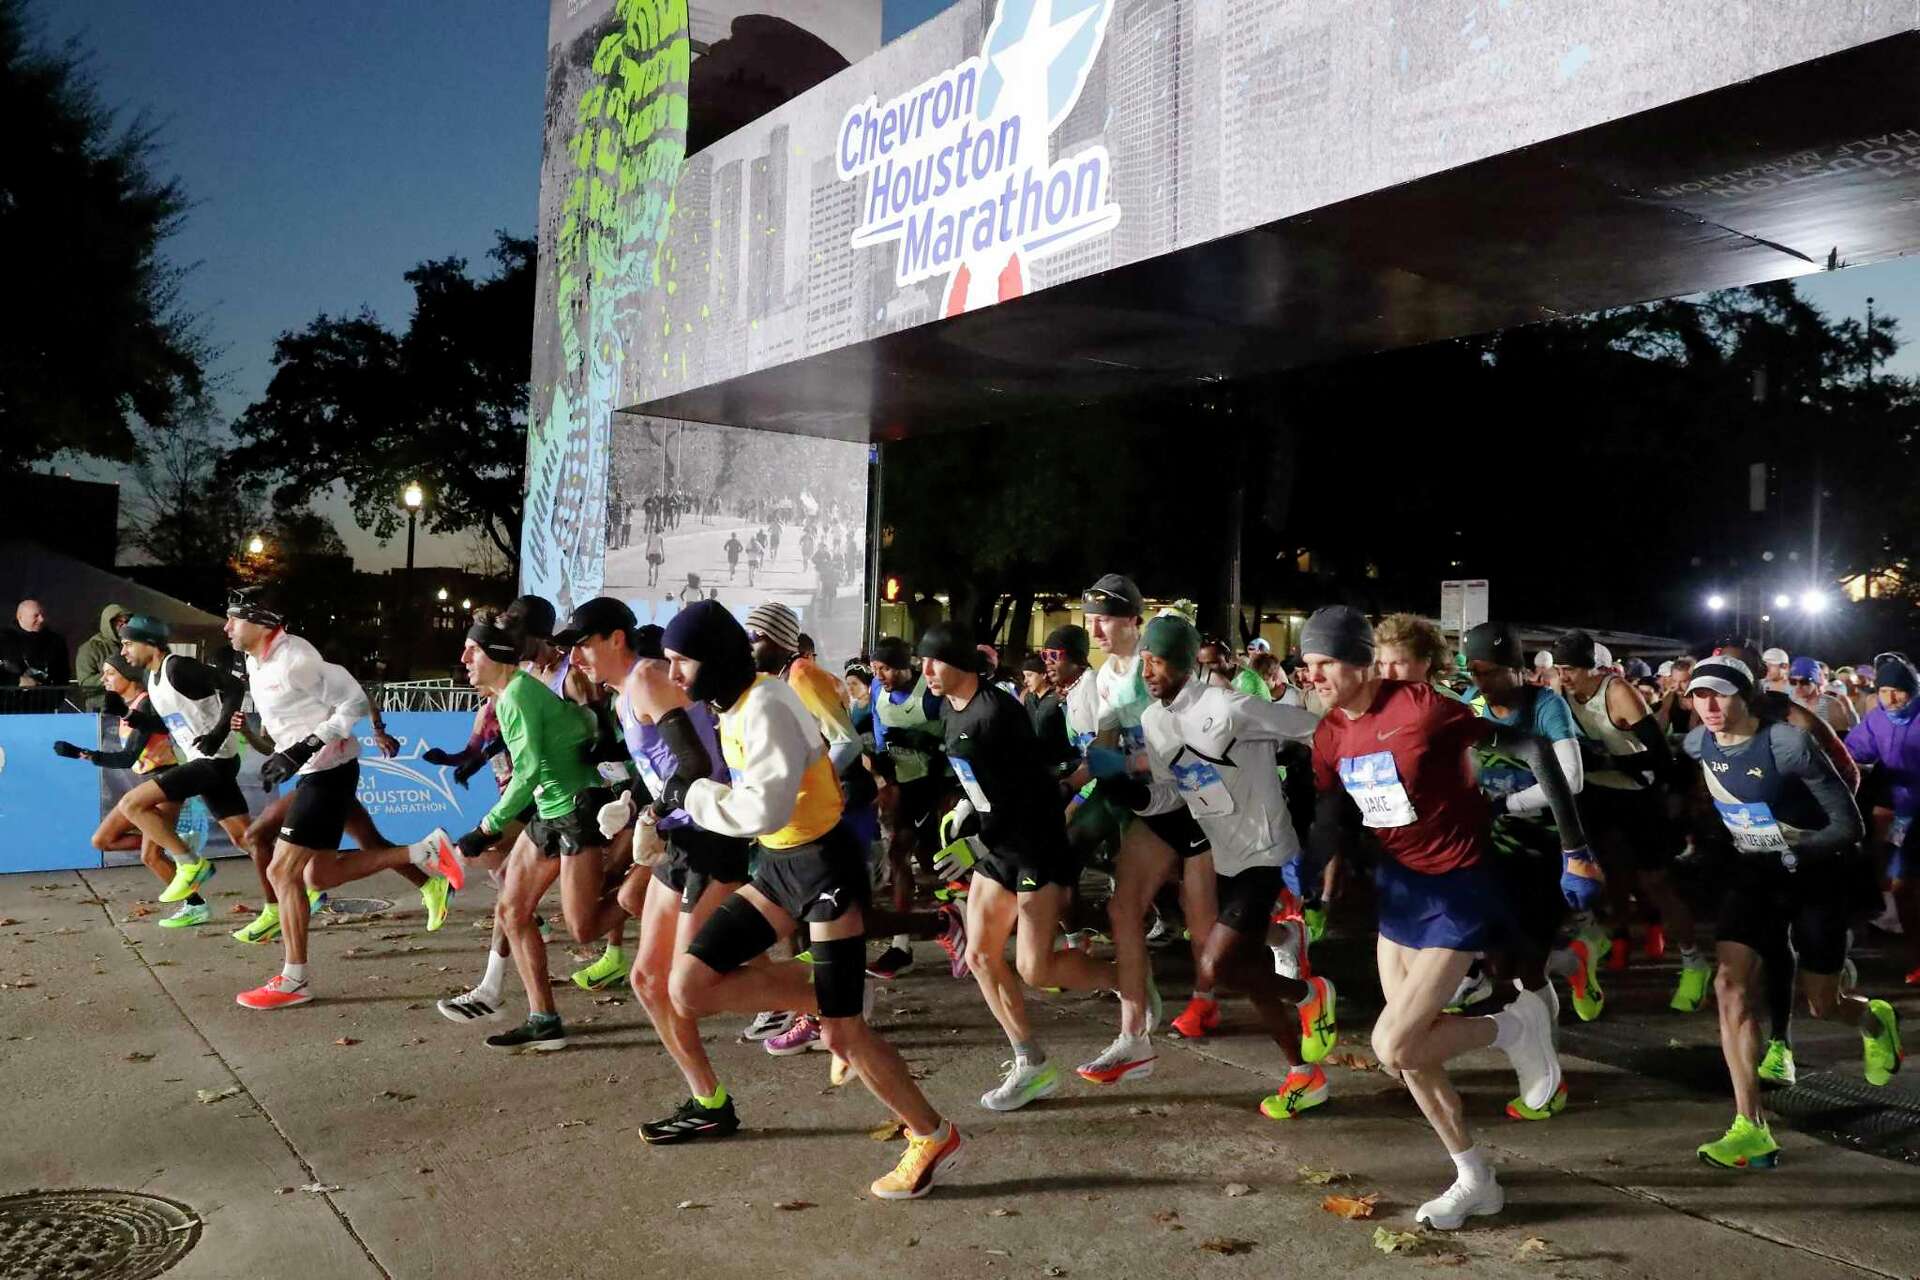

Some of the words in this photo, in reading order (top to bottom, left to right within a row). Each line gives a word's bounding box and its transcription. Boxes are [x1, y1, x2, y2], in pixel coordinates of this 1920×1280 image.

[841, 66, 976, 172] Chevron
[868, 114, 1021, 225] Houston
[902, 157, 1100, 277] Marathon
[357, 789, 431, 804] OUSTON
[385, 802, 447, 815] MARATHON
[1364, 795, 1392, 813] JAKE
